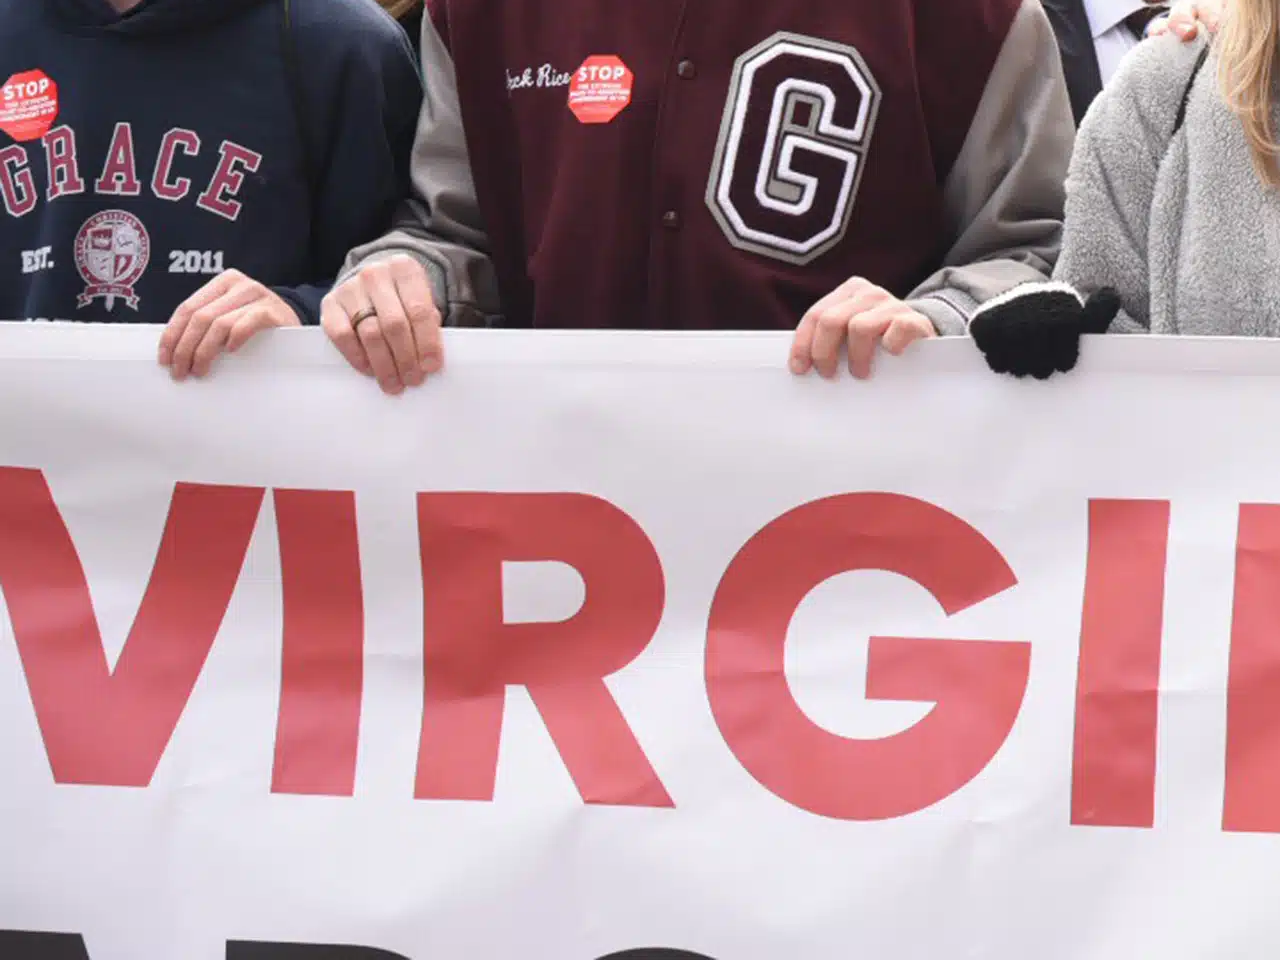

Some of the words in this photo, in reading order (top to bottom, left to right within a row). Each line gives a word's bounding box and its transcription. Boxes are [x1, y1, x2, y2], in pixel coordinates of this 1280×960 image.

[536, 63, 571, 88] Rice
[577, 65, 625, 82] STOP
[3, 77, 49, 101] STOP
[705, 30, 882, 266] G
[0, 122, 262, 221] GRACE
[21, 246, 54, 273] EST.
[169, 250, 225, 273] 2011
